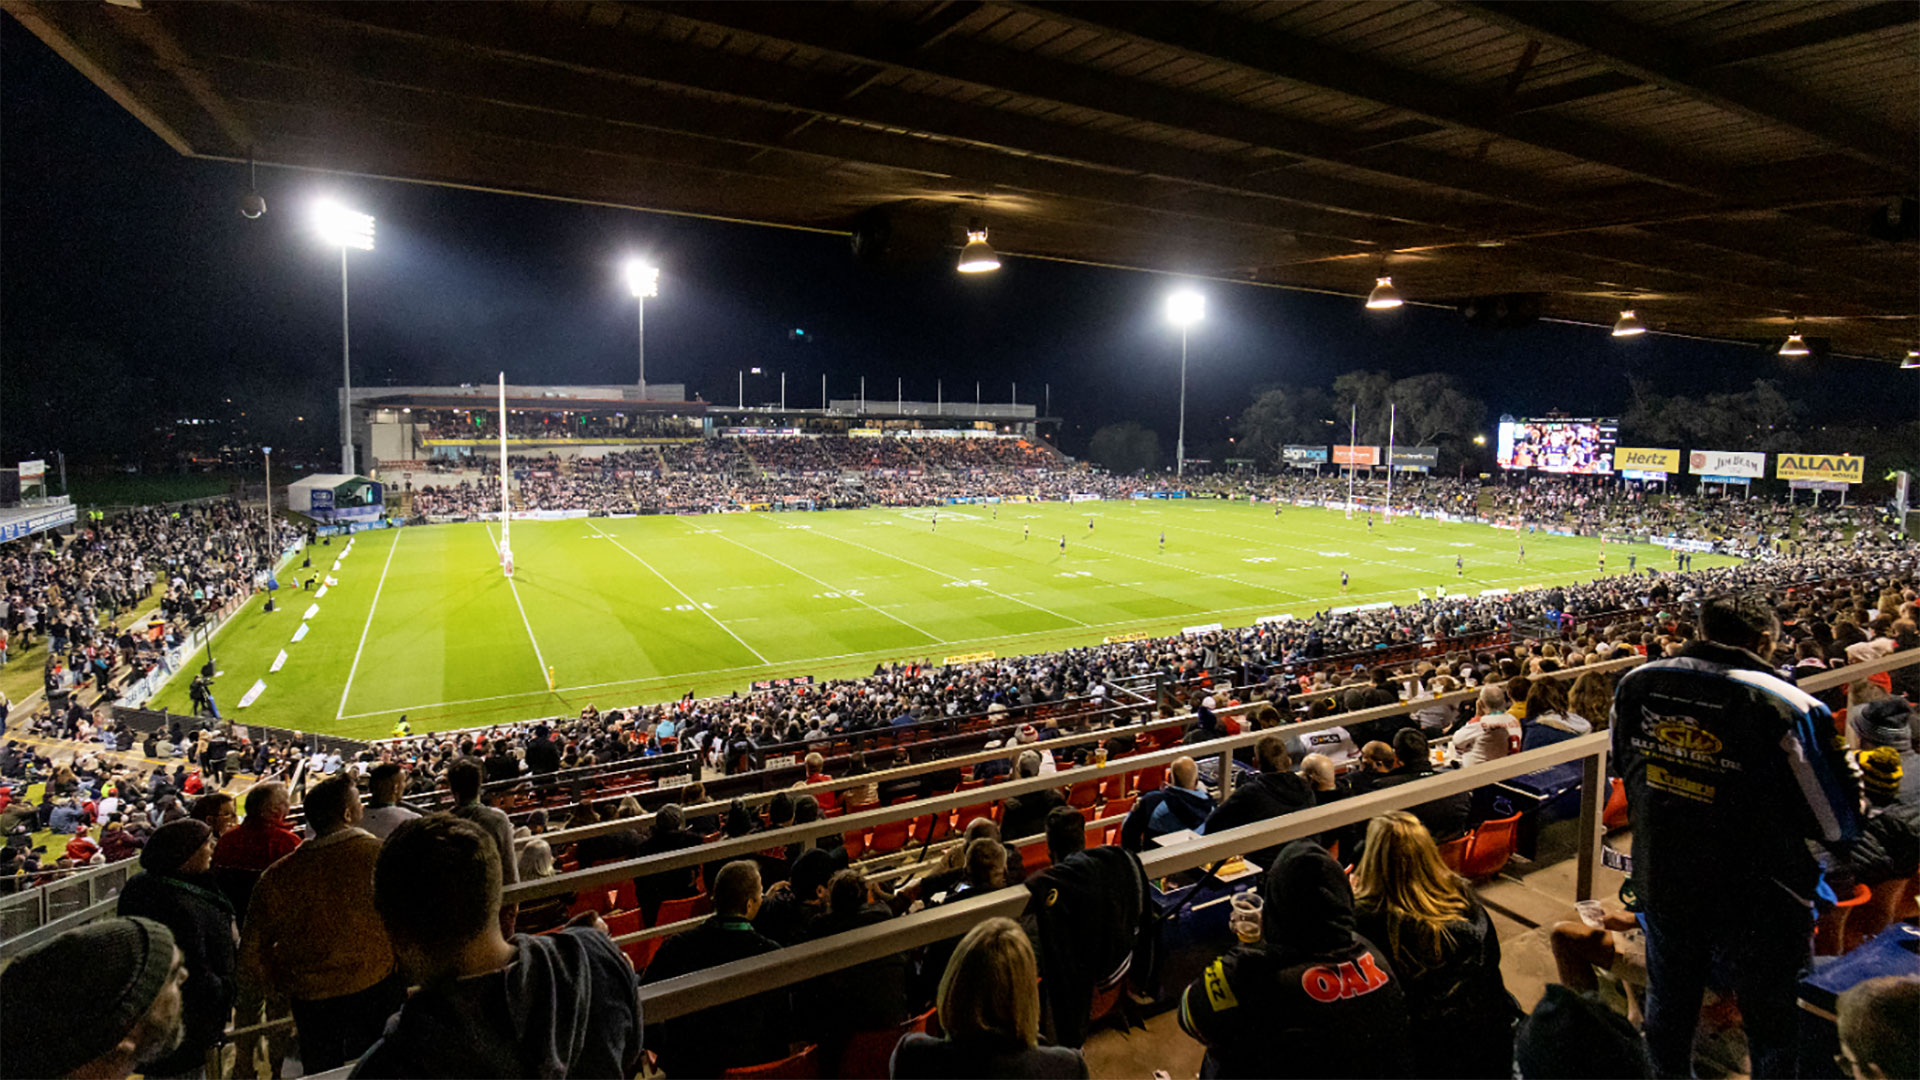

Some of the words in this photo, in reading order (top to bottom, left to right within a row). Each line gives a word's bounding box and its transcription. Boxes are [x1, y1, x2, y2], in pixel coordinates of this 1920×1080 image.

[1626, 452, 1667, 465] Hertz
[1714, 457, 1731, 470] JIM
[1780, 457, 1859, 472] ALLAM
[1302, 952, 1389, 1003] OAK
